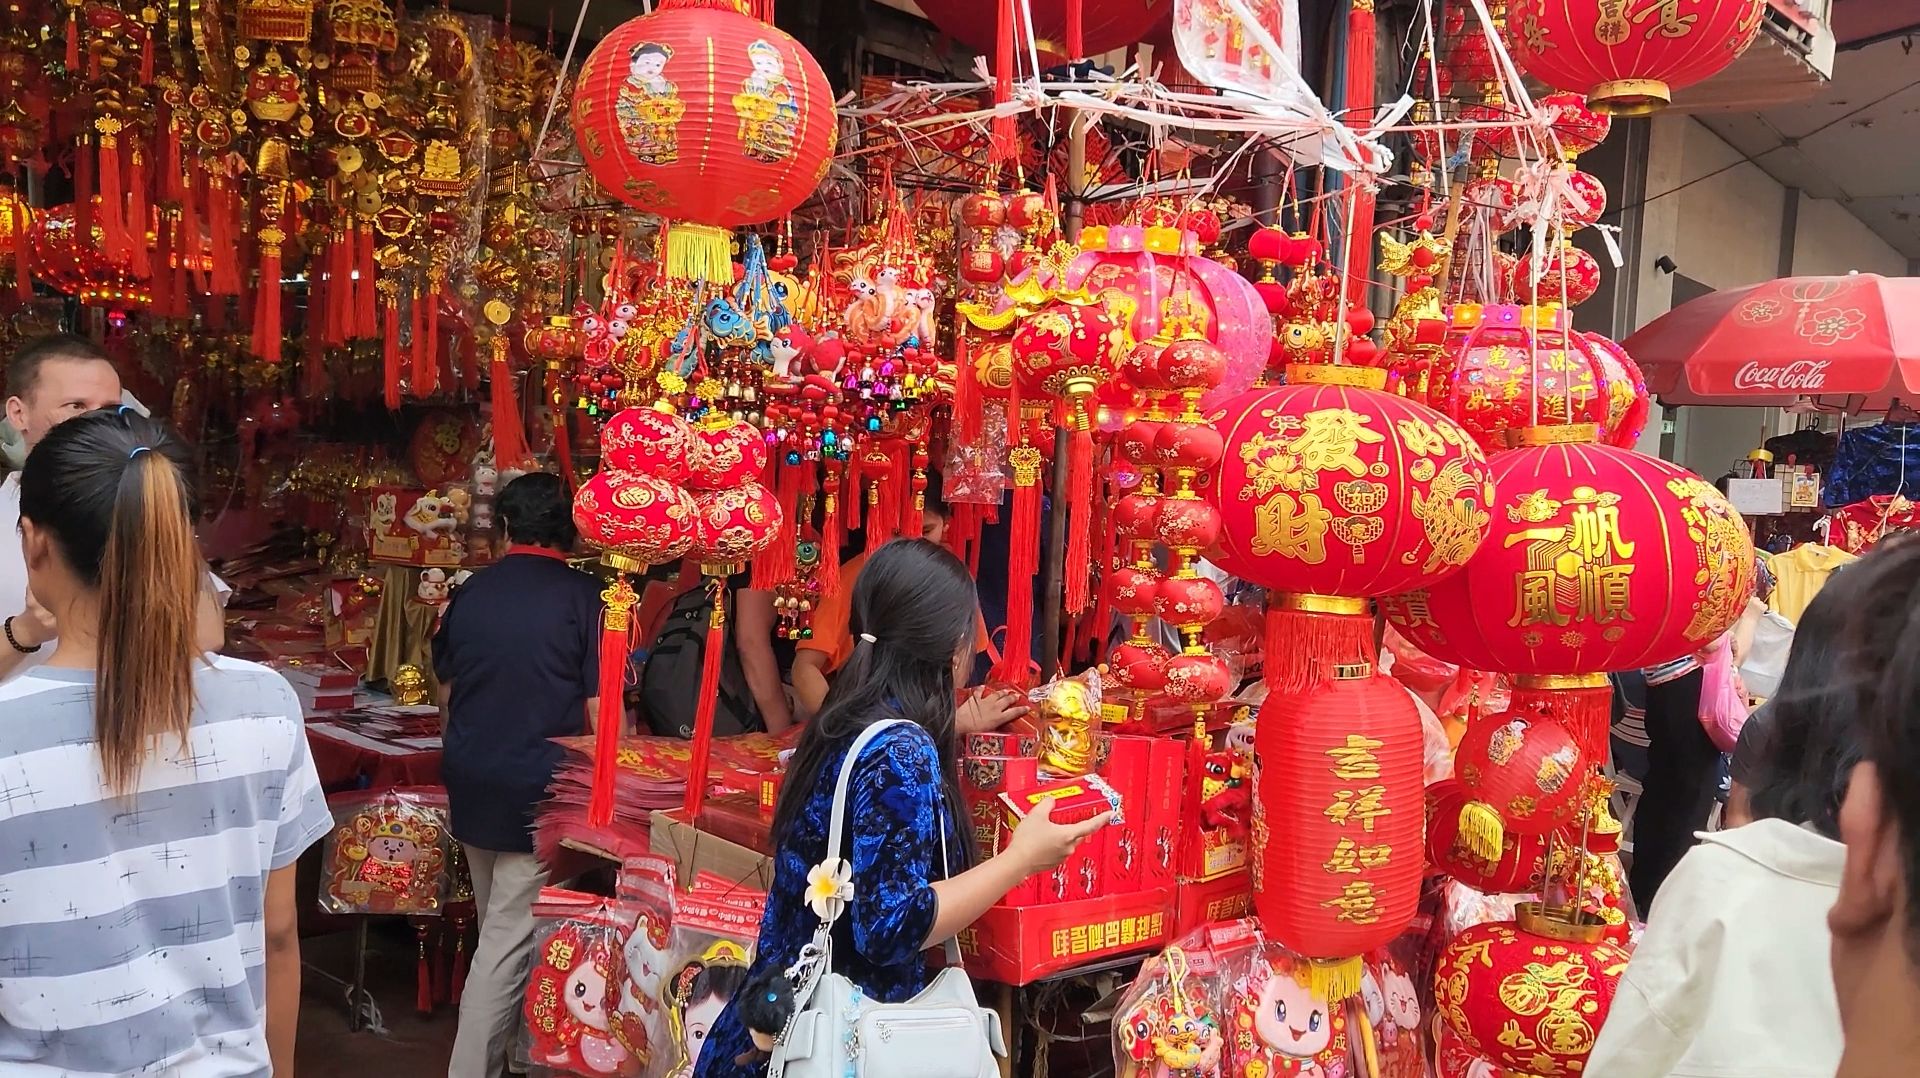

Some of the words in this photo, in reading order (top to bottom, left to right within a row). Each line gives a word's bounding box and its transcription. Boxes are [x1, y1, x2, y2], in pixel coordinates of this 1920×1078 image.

[1734, 360, 1832, 389] Coca-Cola
[1320, 734, 1393, 925] 吉祥如意
